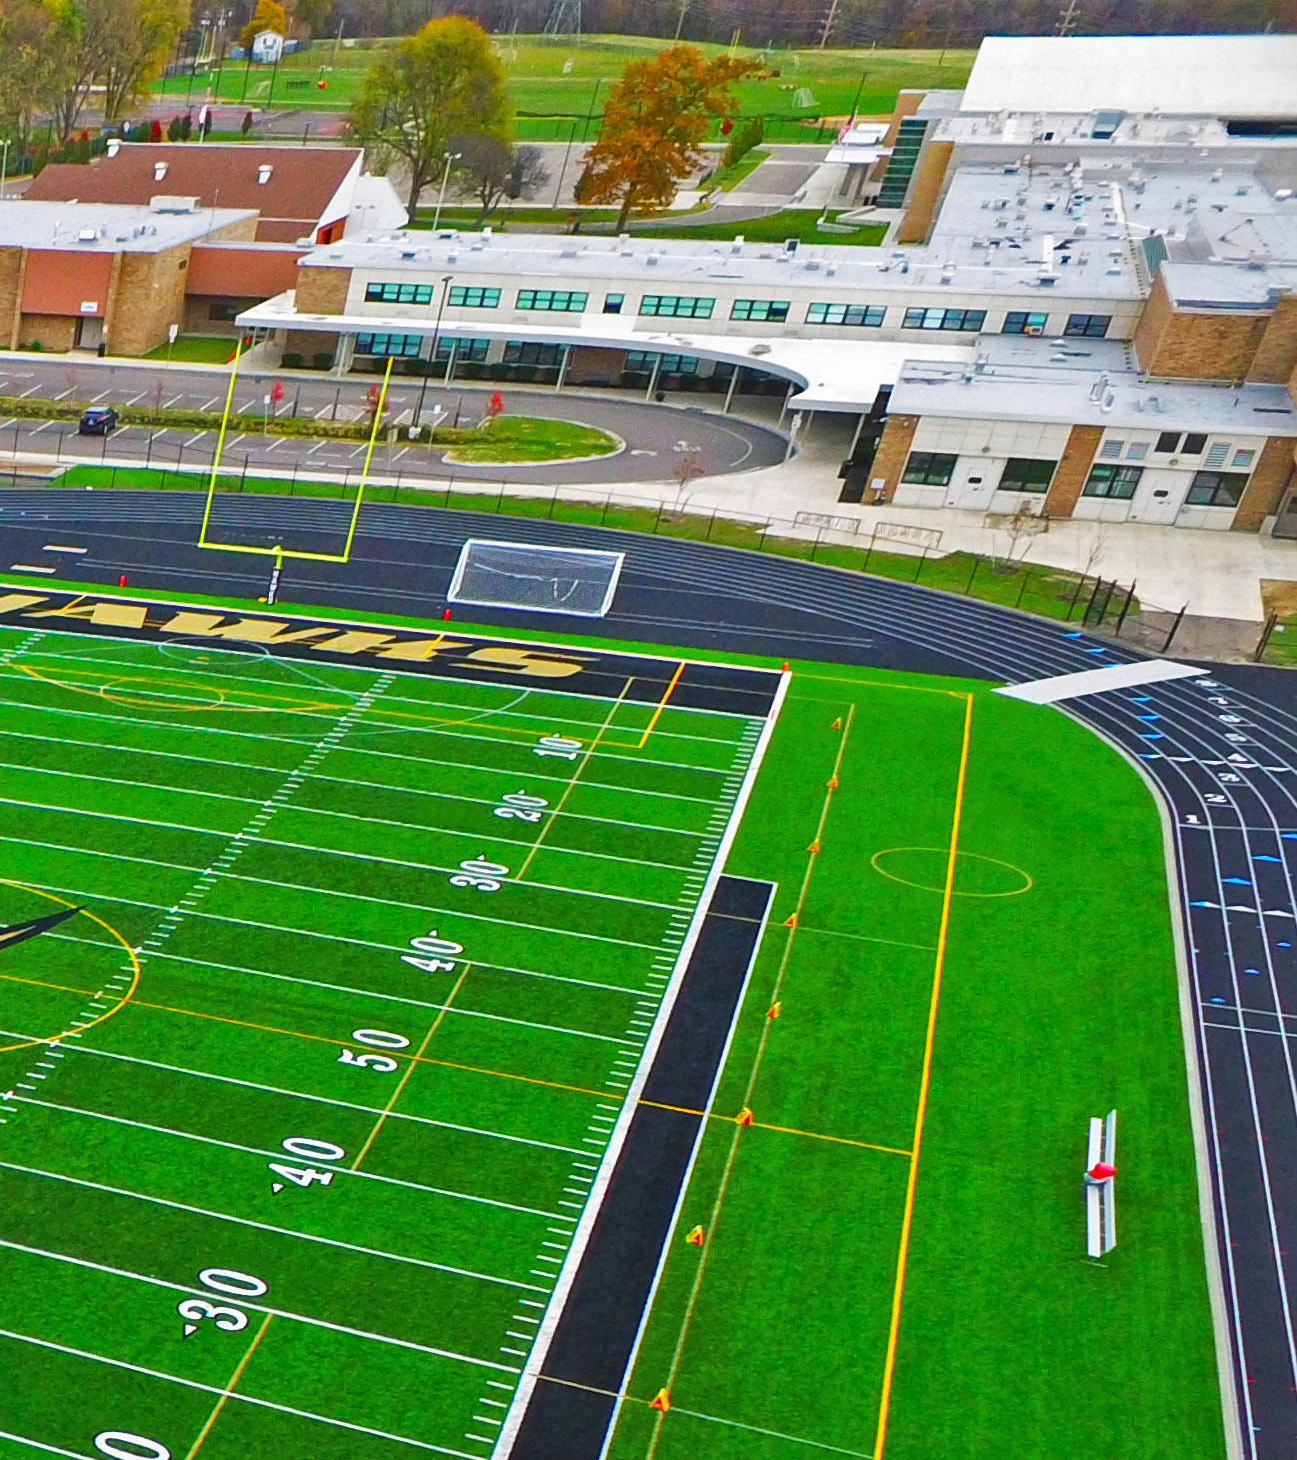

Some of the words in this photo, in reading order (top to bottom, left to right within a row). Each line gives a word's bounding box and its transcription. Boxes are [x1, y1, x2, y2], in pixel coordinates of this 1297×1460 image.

[534, 736, 583, 760] 10
[494, 792, 548, 821] 20
[449, 859, 509, 891] 30
[401, 935, 464, 973] 40
[338, 1029, 409, 1072] 50
[268, 1137, 347, 1187] 40
[178, 1267, 268, 1333] 30
